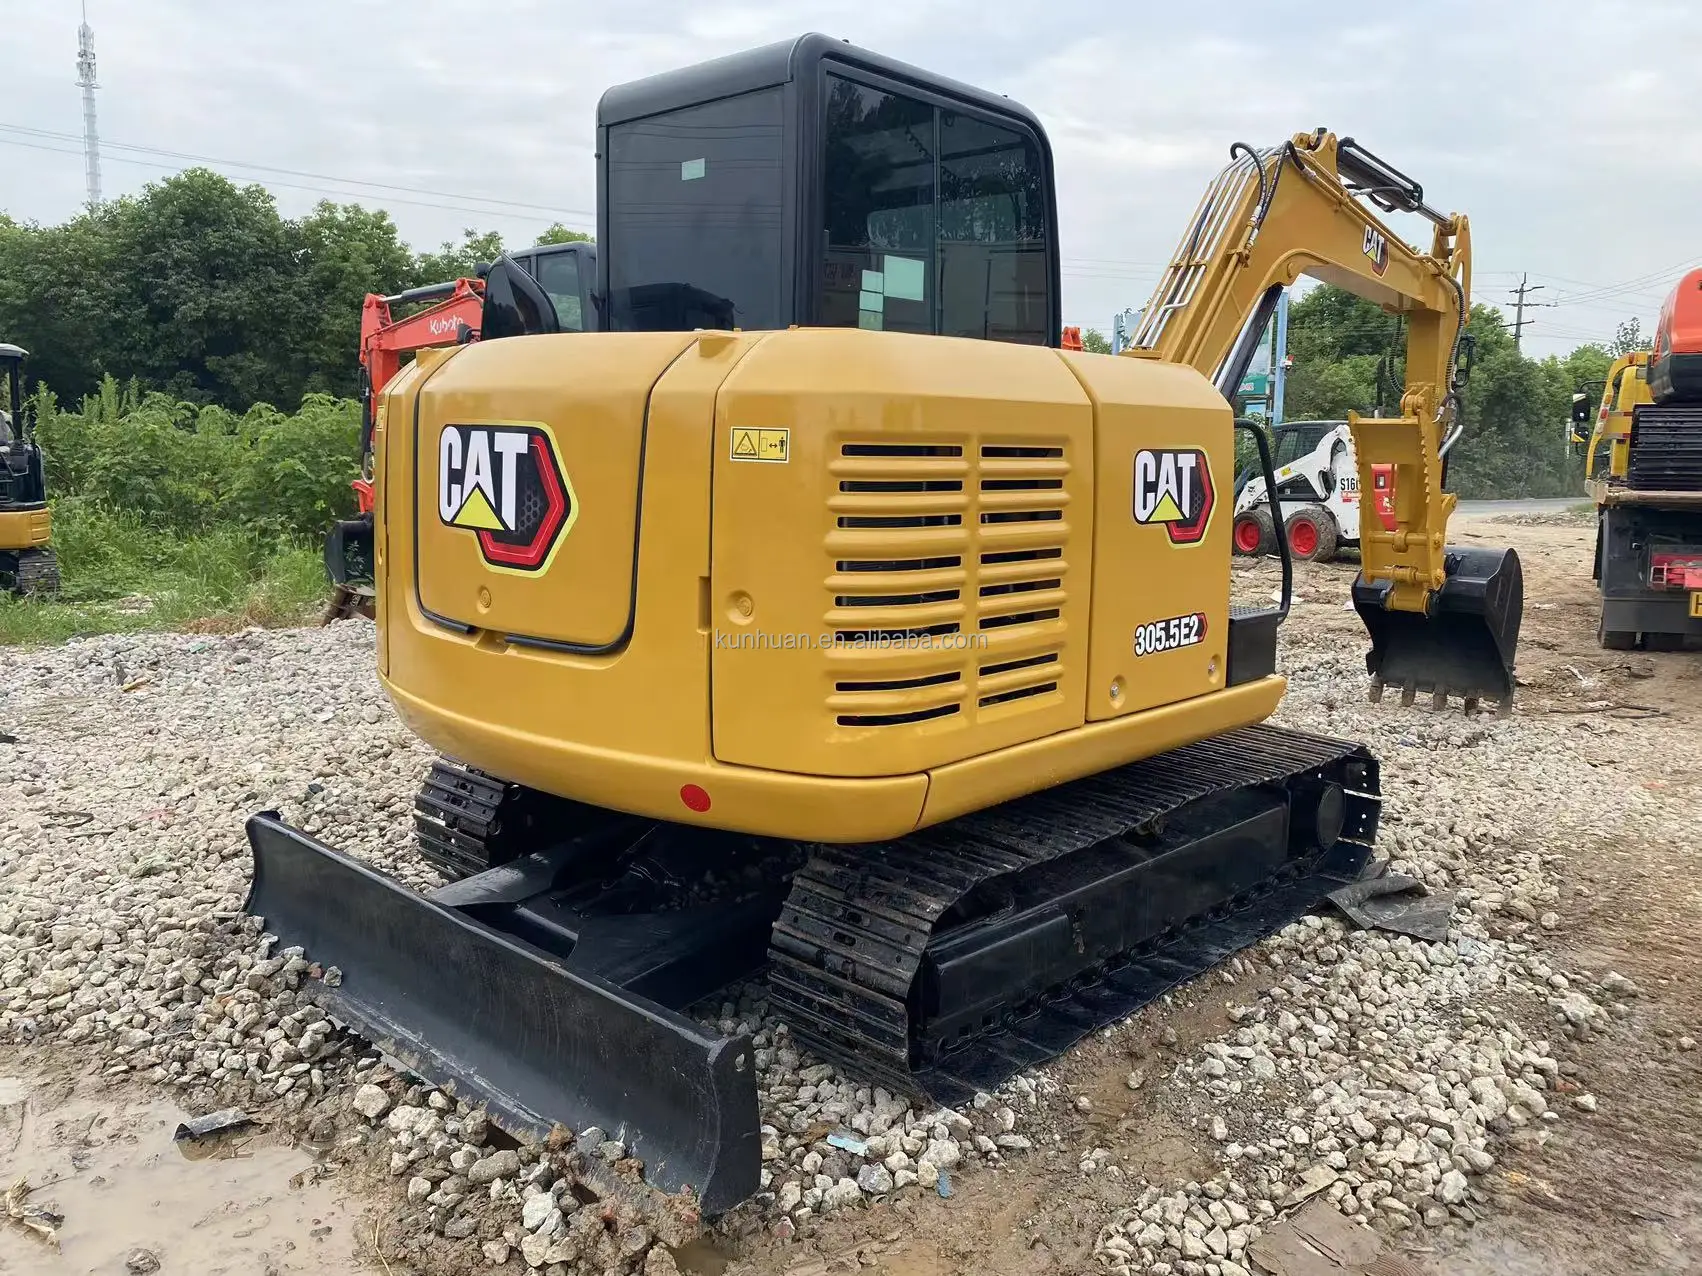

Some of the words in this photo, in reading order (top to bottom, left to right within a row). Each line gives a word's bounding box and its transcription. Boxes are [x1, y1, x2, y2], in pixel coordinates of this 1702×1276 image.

[1363, 224, 1385, 264] CAT
[440, 426, 528, 531] CAT
[1134, 450, 1196, 522] CAT
[1135, 614, 1199, 656] 305.5E2
